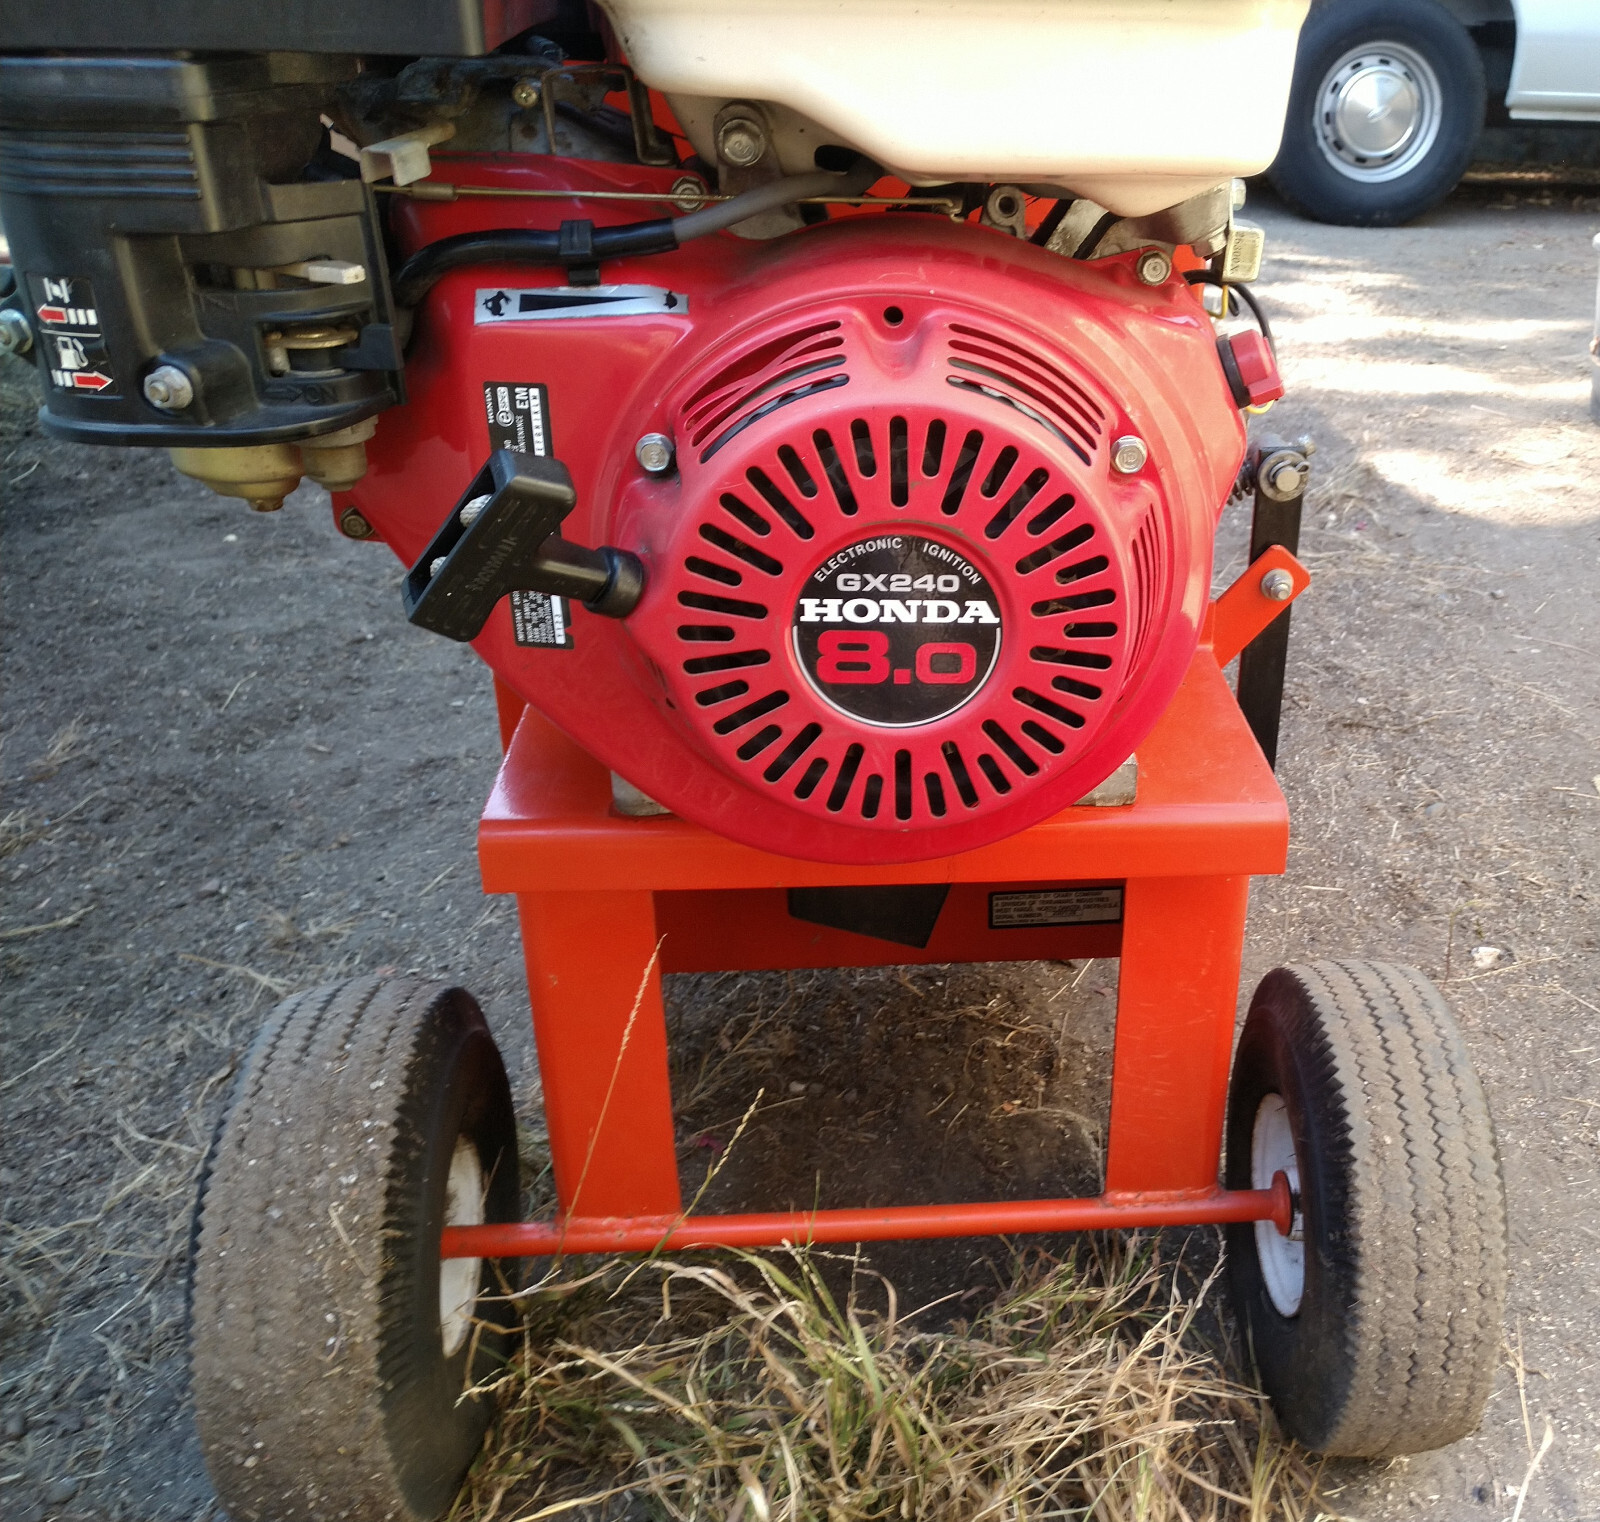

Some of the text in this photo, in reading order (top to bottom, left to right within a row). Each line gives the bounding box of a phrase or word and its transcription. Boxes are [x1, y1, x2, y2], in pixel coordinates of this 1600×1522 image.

[485, 387, 495, 424] HONDA
[515, 387, 529, 410] EM
[813, 537, 982, 585] ELECTRONIC IGNITION
[836, 573, 960, 593] GX240
[799, 598, 1000, 624] HONDA
[816, 629, 977, 685] 8.0
